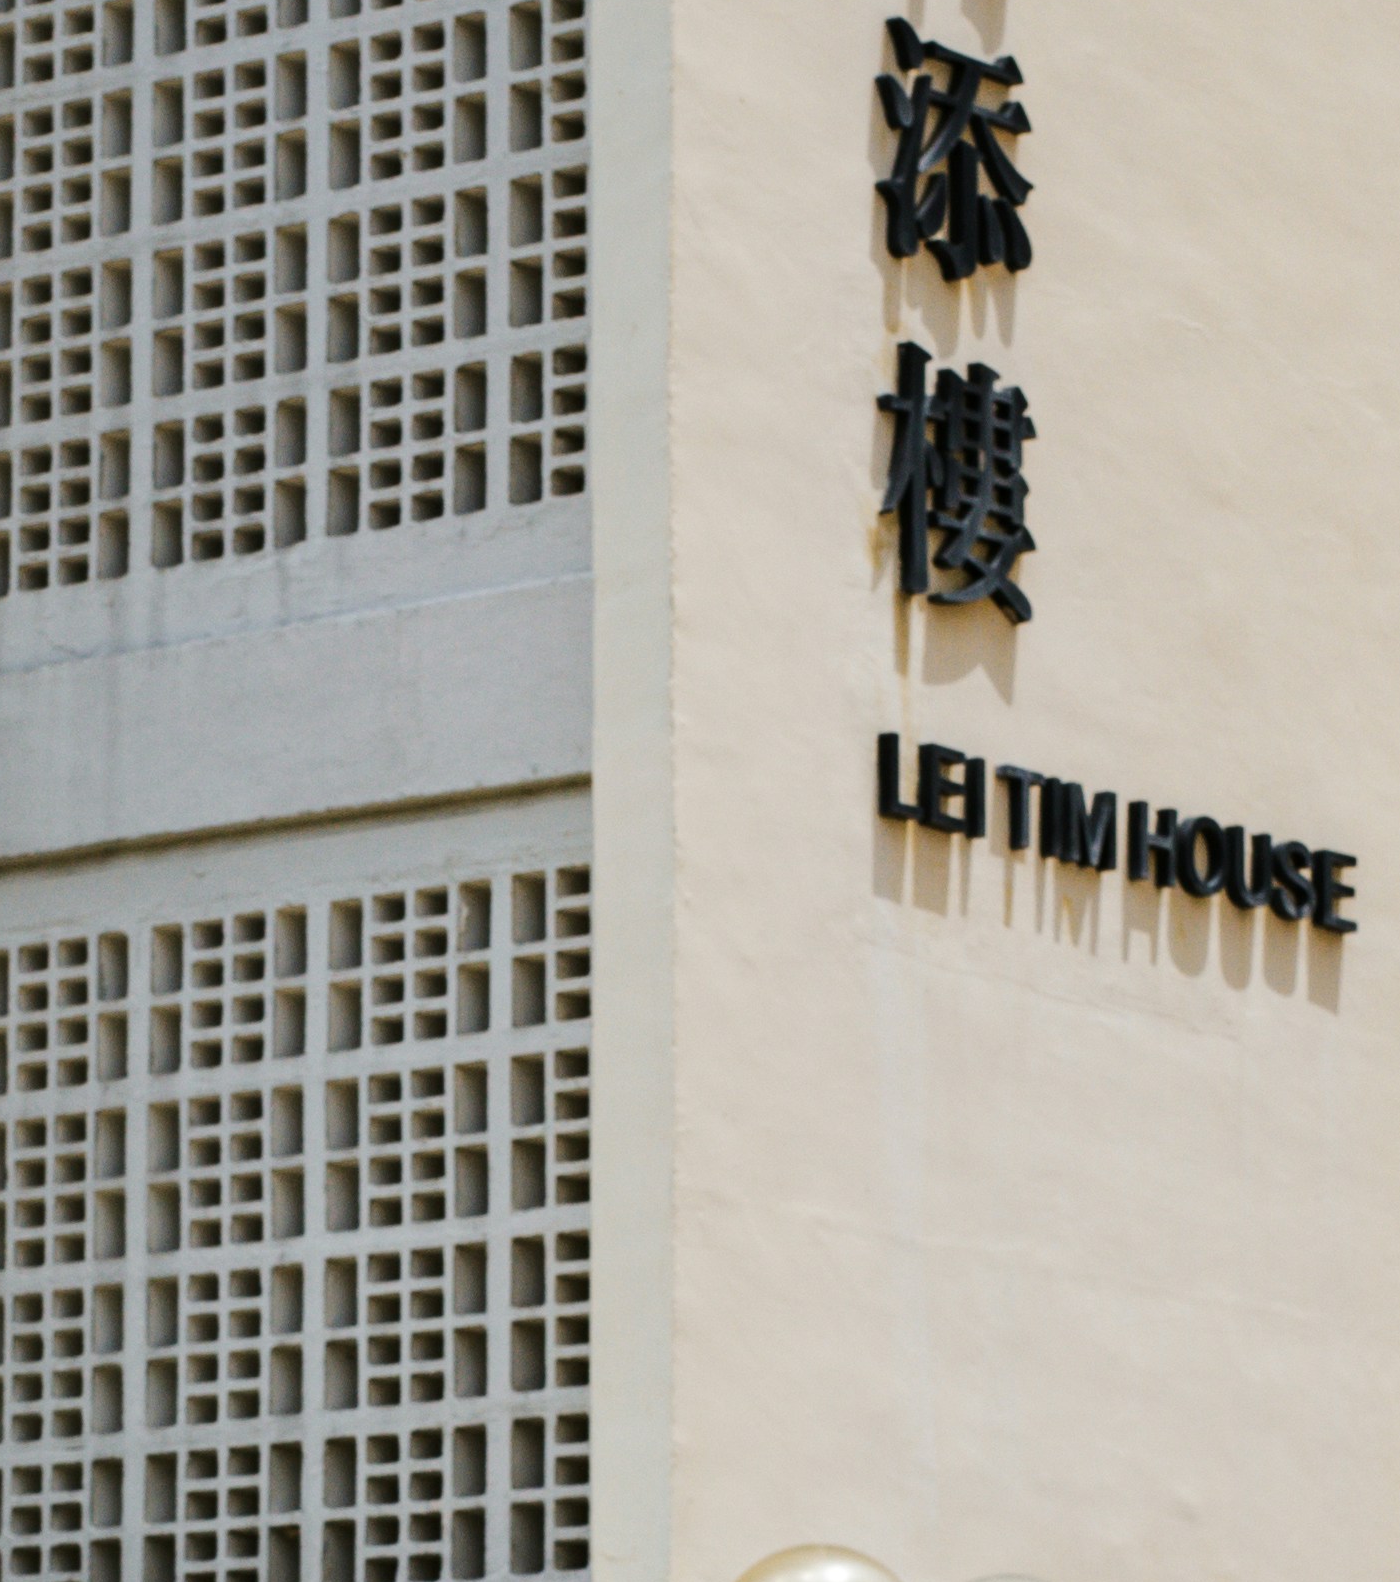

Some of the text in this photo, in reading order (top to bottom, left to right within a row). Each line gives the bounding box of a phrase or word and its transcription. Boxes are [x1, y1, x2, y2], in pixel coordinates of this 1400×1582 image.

[877, 732, 1358, 934] LEI TIM HOUSE
